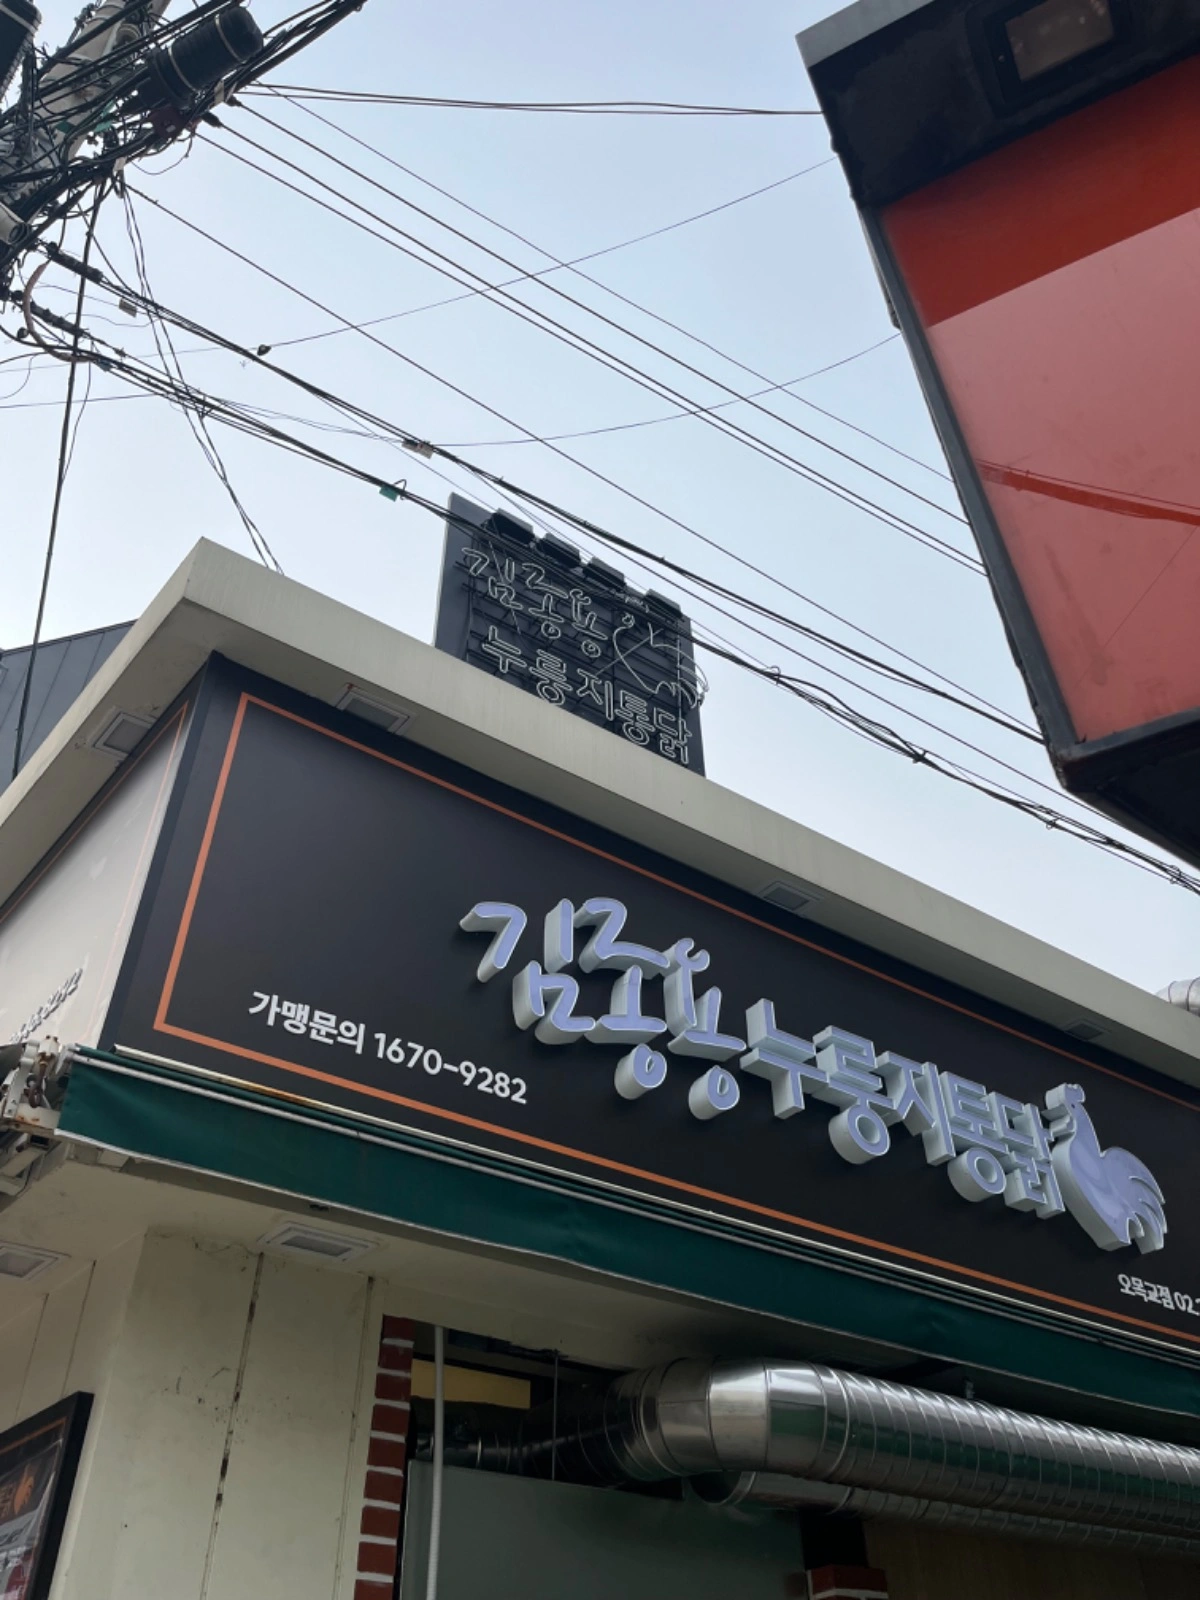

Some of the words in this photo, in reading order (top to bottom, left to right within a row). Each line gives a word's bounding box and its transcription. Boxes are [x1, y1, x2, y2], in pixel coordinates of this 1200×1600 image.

[461, 547, 608, 658] 김종용
[481, 625, 692, 765] 누룽지통닭
[249, 991, 366, 1054] 가맹문의
[374, 1033, 527, 1104] 1670-9282
[1117, 1273, 1175, 1310] 오목교점
[1173, 1291, 1200, 1316] 02
